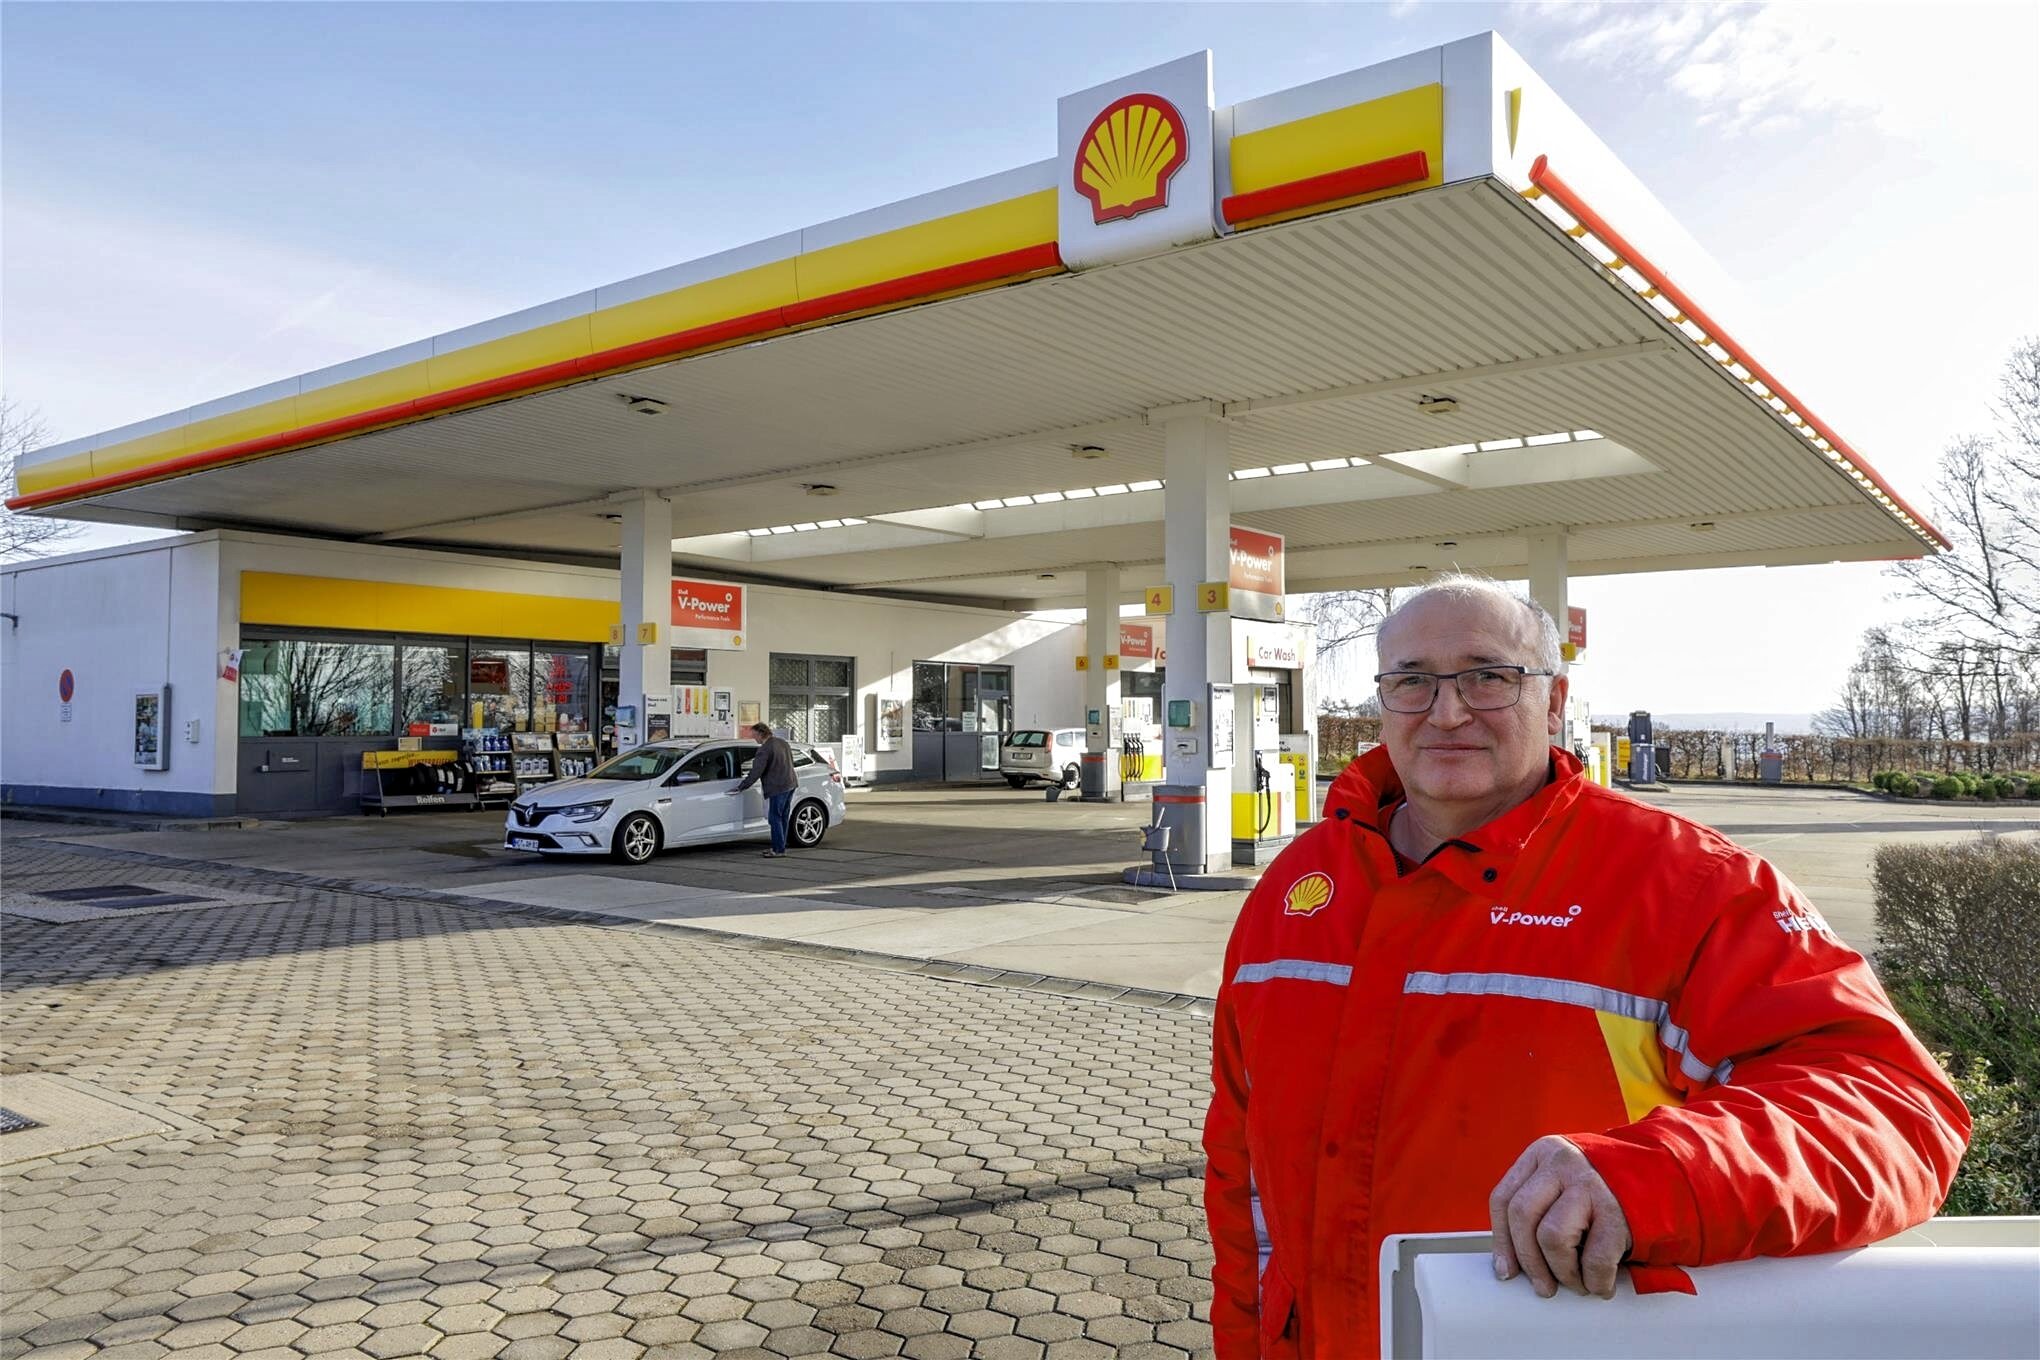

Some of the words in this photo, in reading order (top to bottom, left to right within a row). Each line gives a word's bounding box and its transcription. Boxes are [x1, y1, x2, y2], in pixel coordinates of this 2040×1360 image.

[1230, 548, 1272, 572] V-Power
[1151, 593, 1162, 607] 4
[1207, 589, 1217, 604] 3
[678, 596, 730, 613] V-Power
[1120, 634, 1147, 647] V-Power
[1259, 646, 1272, 660] Car
[1274, 647, 1296, 661] Wash
[415, 794, 445, 805] Reifen
[1490, 911, 1574, 927] V-Power
